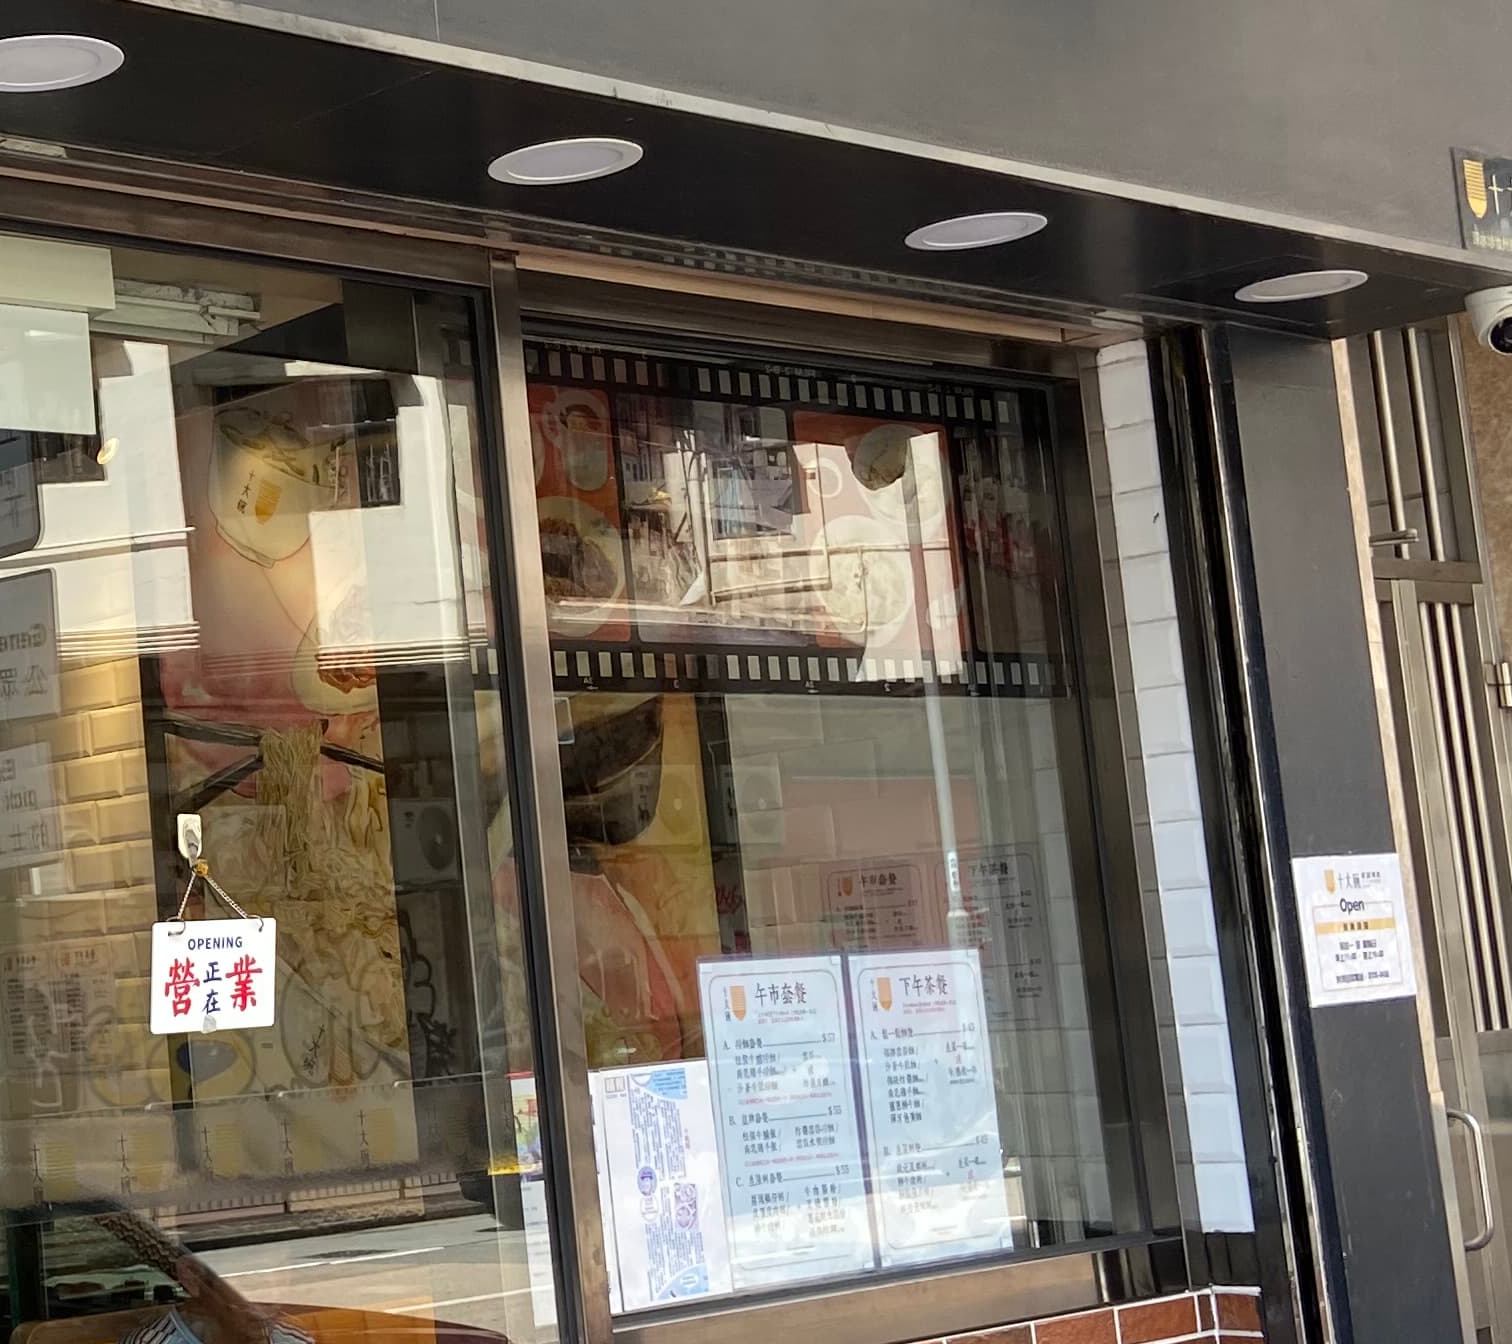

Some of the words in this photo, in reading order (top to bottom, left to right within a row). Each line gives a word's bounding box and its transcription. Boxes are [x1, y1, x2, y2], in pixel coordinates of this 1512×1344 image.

[1339, 898, 1365, 916] Open
[188, 935, 244, 951] OPENING
[754, 981, 808, 1007] 午市套餐
[898, 973, 948, 997] 下午茶餐
